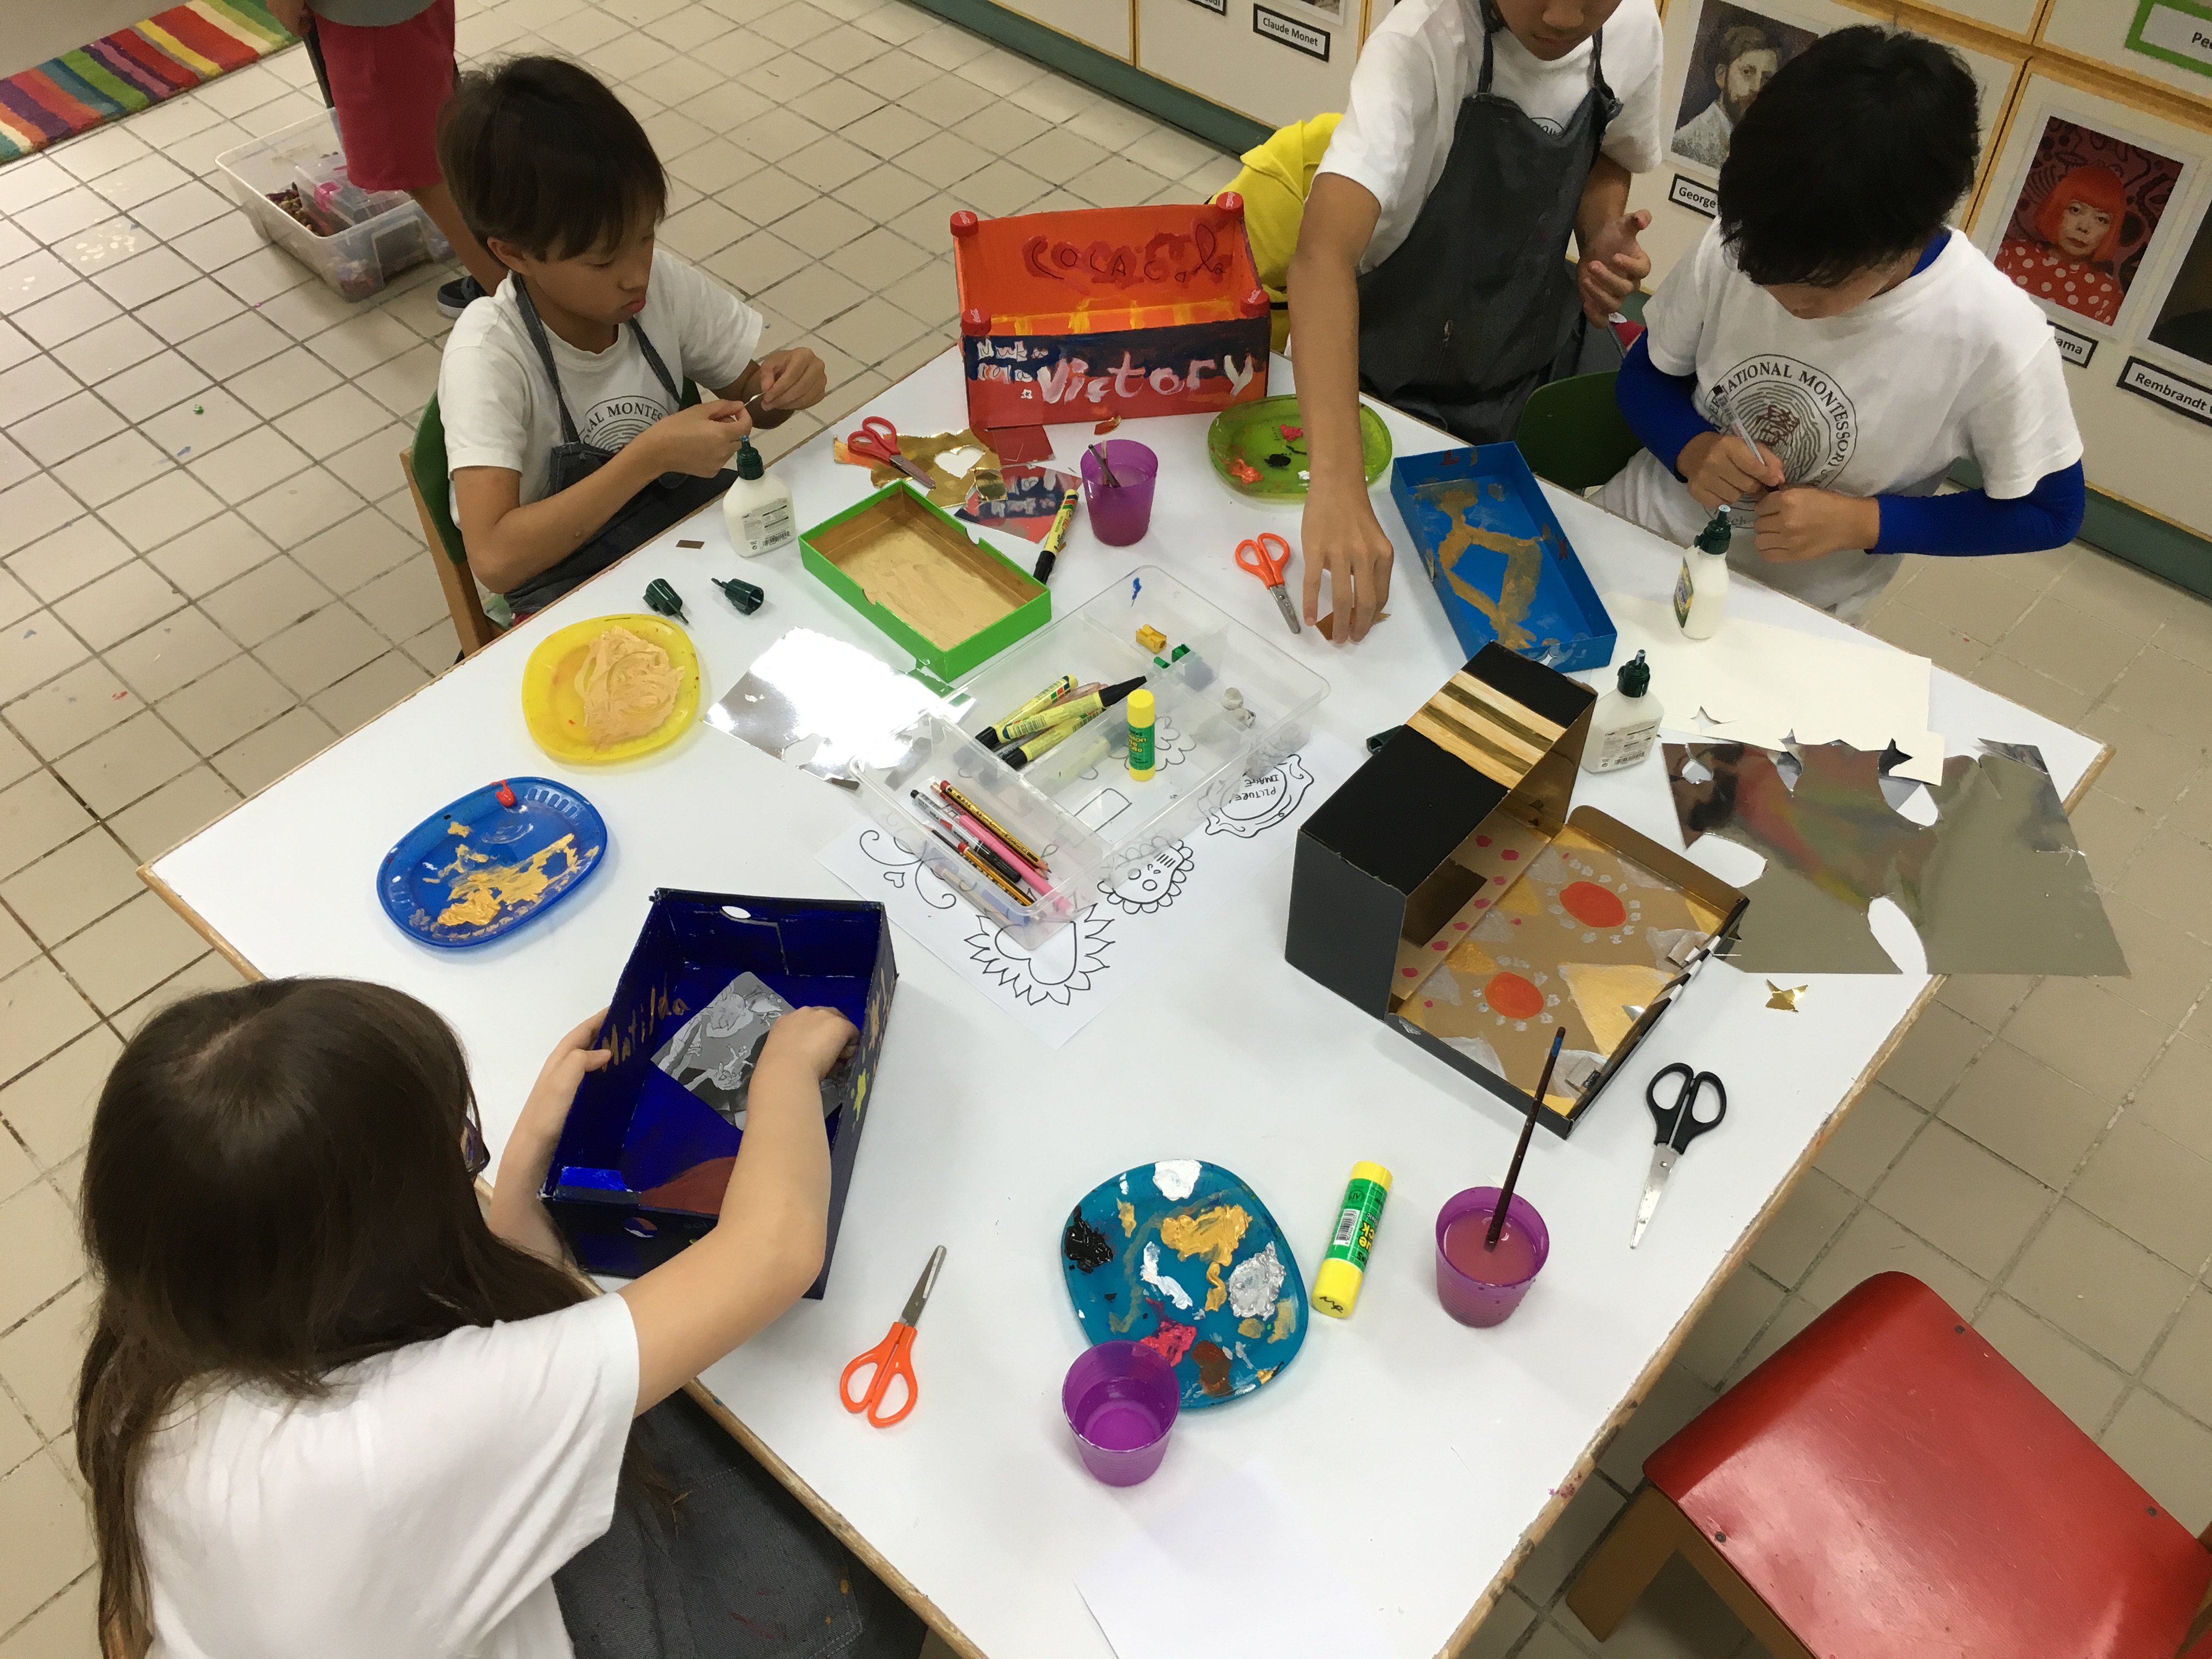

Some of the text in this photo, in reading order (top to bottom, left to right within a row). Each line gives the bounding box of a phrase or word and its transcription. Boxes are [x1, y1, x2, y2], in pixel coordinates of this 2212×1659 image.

[1263, 17, 1318, 47] Claude Monet
[1679, 187, 1716, 208] George
[2054, 336, 2083, 355] ama
[1037, 350, 1255, 404] Victory
[2135, 373, 2208, 411] Rembrandt
[1235, 786, 1276, 801] PICTURE
[602, 972, 691, 1073] Matilda
